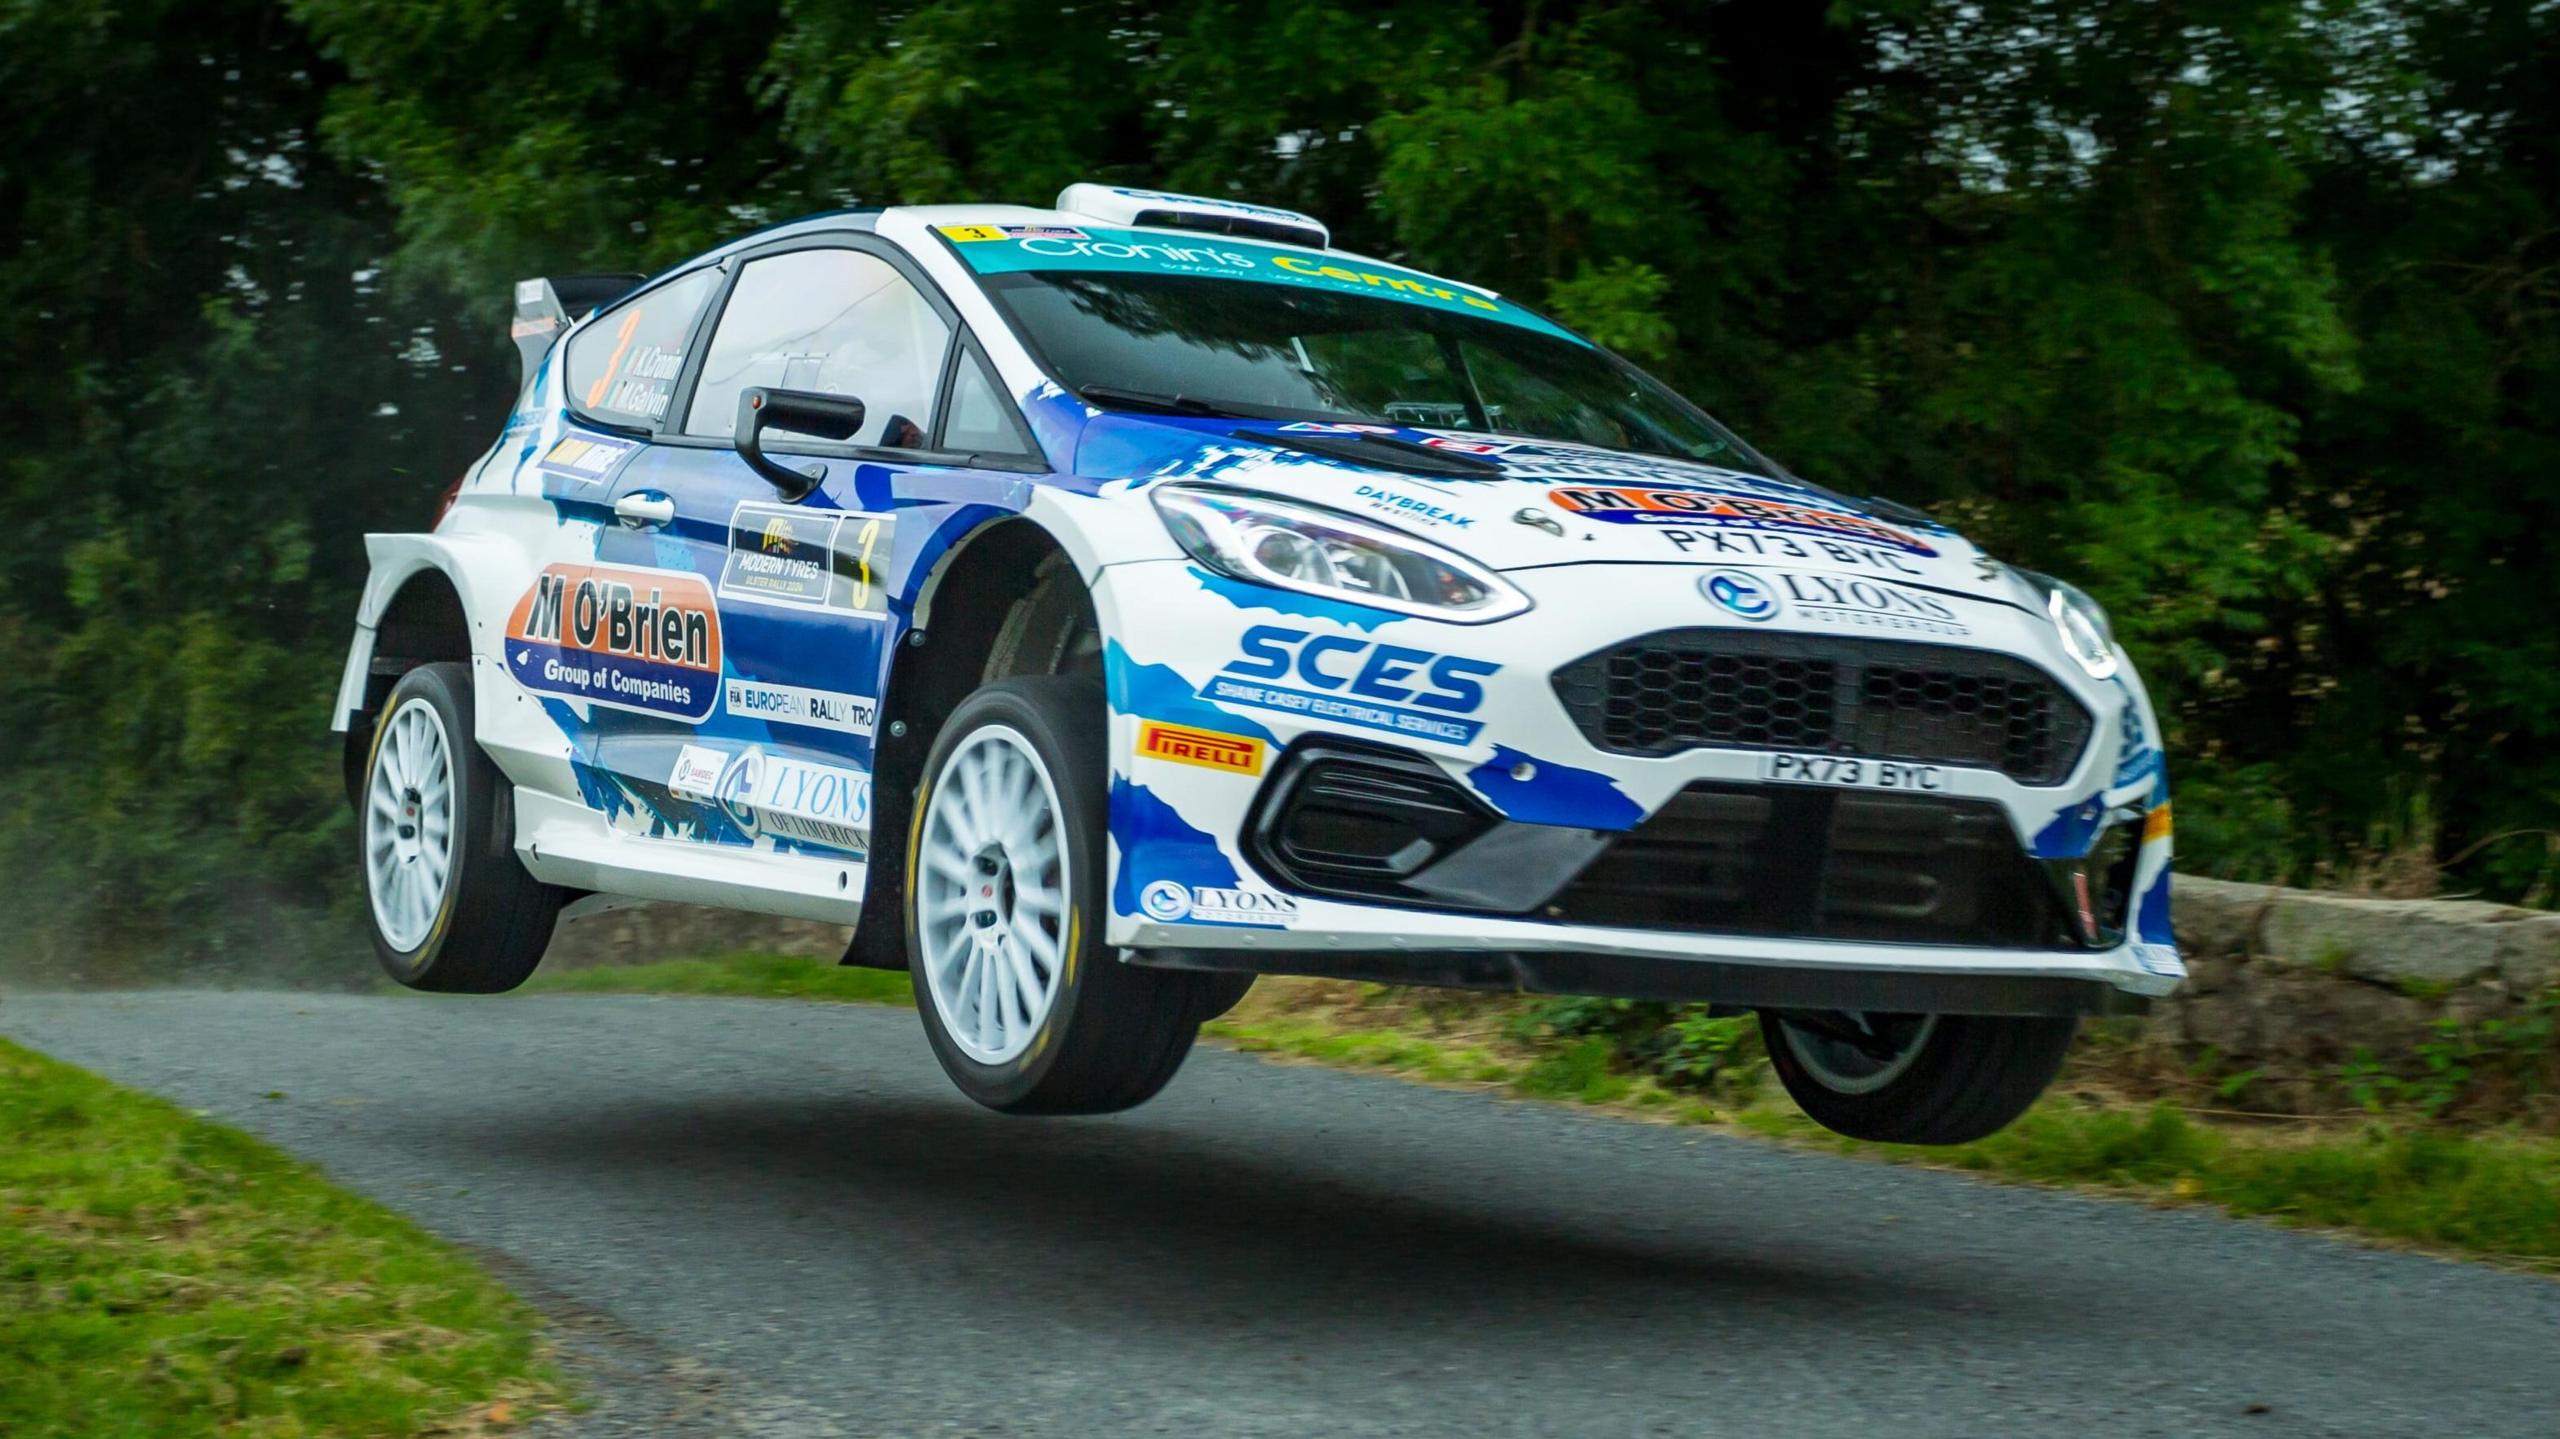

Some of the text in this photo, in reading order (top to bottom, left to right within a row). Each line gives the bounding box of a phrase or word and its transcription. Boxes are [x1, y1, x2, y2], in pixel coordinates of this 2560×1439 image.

[966, 227, 988, 239] 3
[1019, 237, 1257, 269] Cronin's
[1271, 256, 1500, 312] Centra
[585, 309, 641, 409] 3
[1354, 485, 1475, 528] DAYBREAK
[1562, 489, 1926, 551] M O'Brien
[738, 554, 819, 580] MODERN TYRES
[853, 518, 880, 610] 3
[1661, 528, 1923, 575] PX73 BYC
[1776, 573, 1957, 620] LYONS
[523, 573, 710, 669] M O'Brien
[543, 658, 691, 705] Group of Companies
[1221, 624, 1505, 714] SCES
[730, 690, 741, 704] FIA
[745, 689, 806, 716] EUROPEAN
[810, 697, 848, 722] RALLY
[1214, 681, 1470, 741] SHANE CASEY ELECTRICAL SERVICES
[1146, 727, 1255, 768] PIRELLI
[768, 766, 871, 824] LYONS
[1772, 754, 1941, 790] PX73 BYC
[769, 811, 870, 850] OF LIMERICK
[1195, 888, 1299, 913] LYONS
